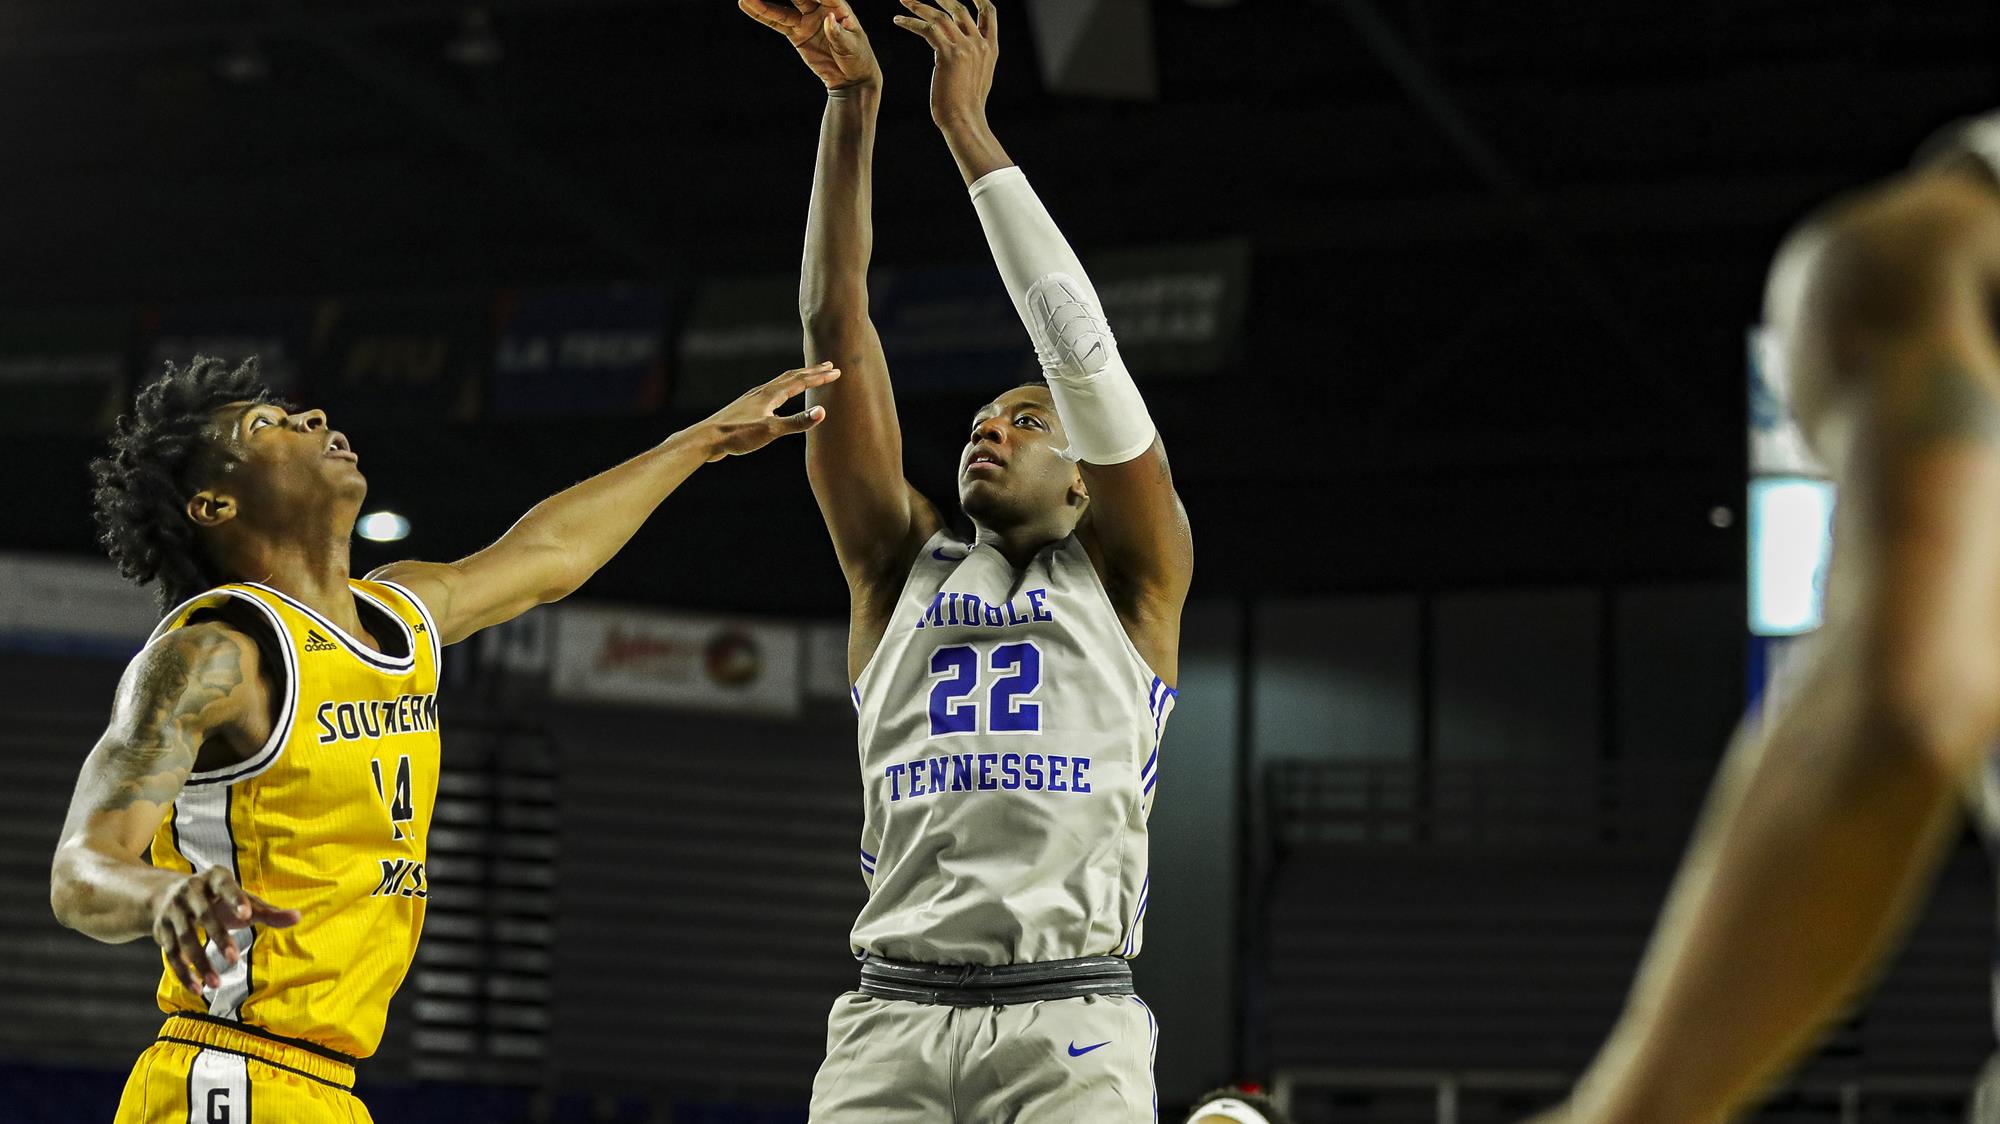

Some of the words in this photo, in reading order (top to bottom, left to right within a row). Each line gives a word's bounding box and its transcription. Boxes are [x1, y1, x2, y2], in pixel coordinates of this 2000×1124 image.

[304, 642, 337, 652] adidas
[928, 640, 1043, 739] 22
[885, 753, 1092, 802] TENNESSEE
[206, 1087, 230, 1124] G
